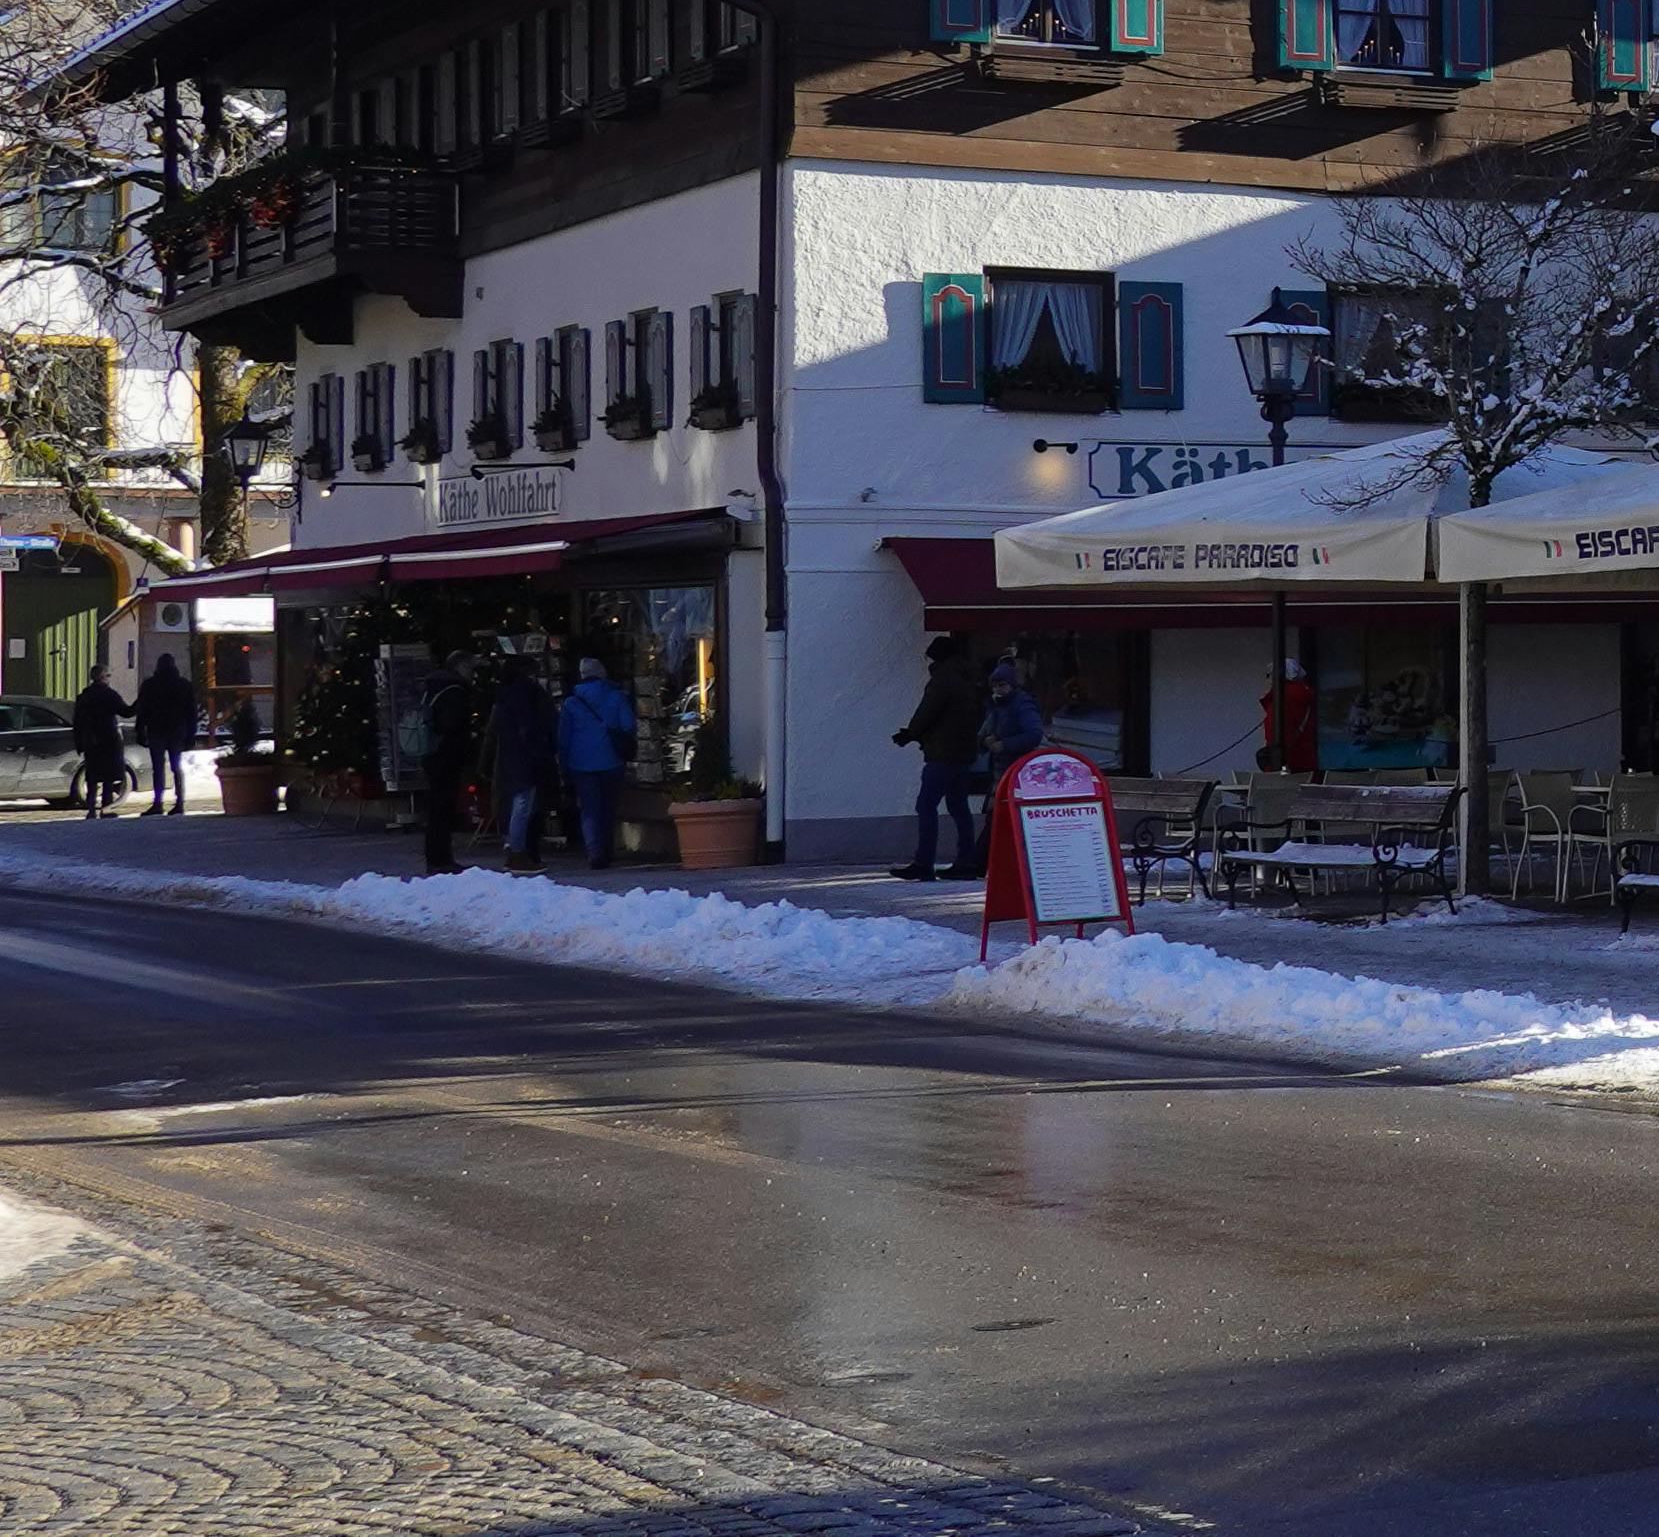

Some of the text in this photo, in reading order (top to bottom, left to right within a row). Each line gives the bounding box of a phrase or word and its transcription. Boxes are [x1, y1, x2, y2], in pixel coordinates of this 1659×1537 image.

[1116, 447, 1270, 494] Käth
[440, 470, 557, 523] Käthe Wohlfahrt
[1103, 543, 1300, 571] EISCAFE PARADISO
[1026, 806, 1098, 820] BRUSCHETTA
